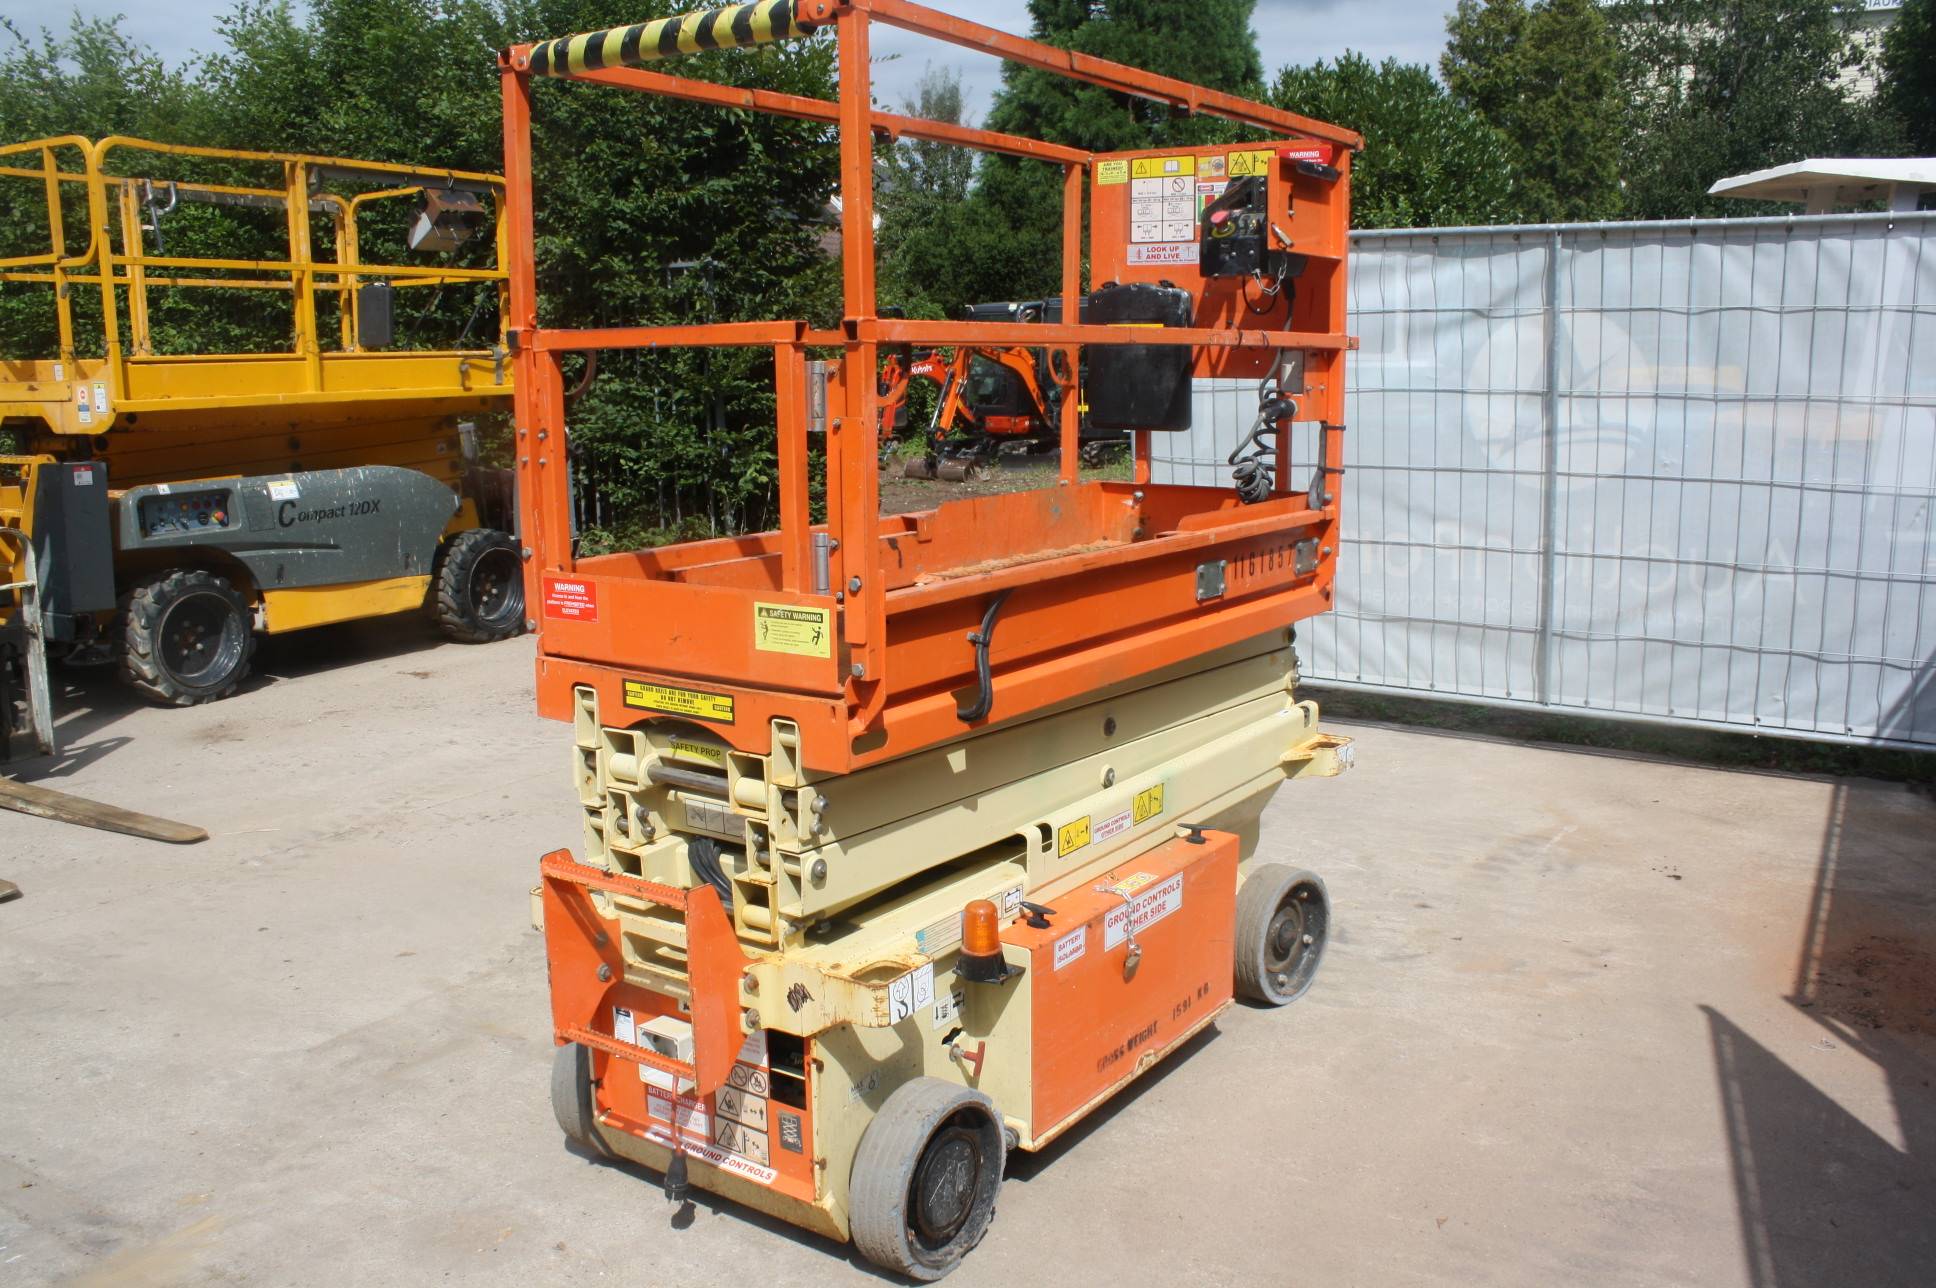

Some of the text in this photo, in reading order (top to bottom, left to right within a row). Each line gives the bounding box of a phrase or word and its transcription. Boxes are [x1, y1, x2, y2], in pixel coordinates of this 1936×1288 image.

[1289, 150, 1320, 159] WARNING
[278, 499, 381, 528] Compact 12DX
[553, 582, 585, 593] WARNING
[769, 609, 821, 622] SAFETY WARNING
[670, 741, 721, 757] SAFETY PROP
[1107, 880, 1181, 928] GROUND CONTROLS
[1150, 900, 1167, 917] SIDE
[1126, 1020, 1158, 1052] WEIGHT
[1172, 995, 1192, 1021] 1591
[648, 1086, 673, 1099] BATTER
[684, 1142, 773, 1181] GROUND CONTROLS
